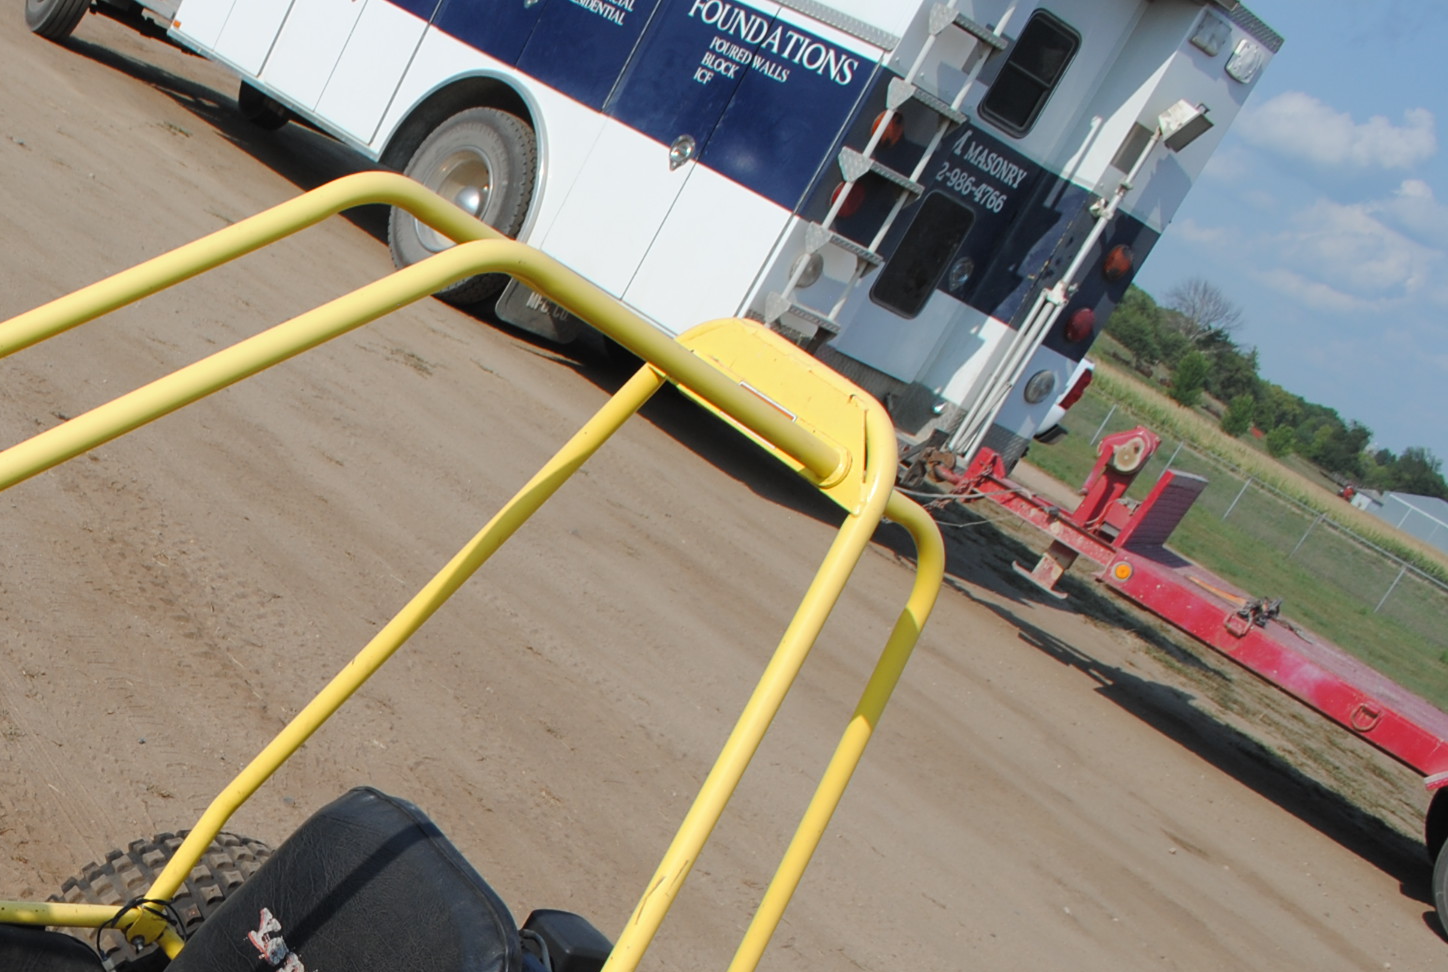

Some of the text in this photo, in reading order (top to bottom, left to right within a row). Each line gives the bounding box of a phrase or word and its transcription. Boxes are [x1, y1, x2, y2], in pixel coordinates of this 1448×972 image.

[688, 0, 859, 86] FOUNDATIONS
[701, 52, 740, 79] BLOCK
[709, 36, 790, 83] POURED WALLS
[693, 67, 714, 85] ICF
[936, 161, 1007, 213] 2-986-4766
[963, 141, 1027, 189] MASONRY
